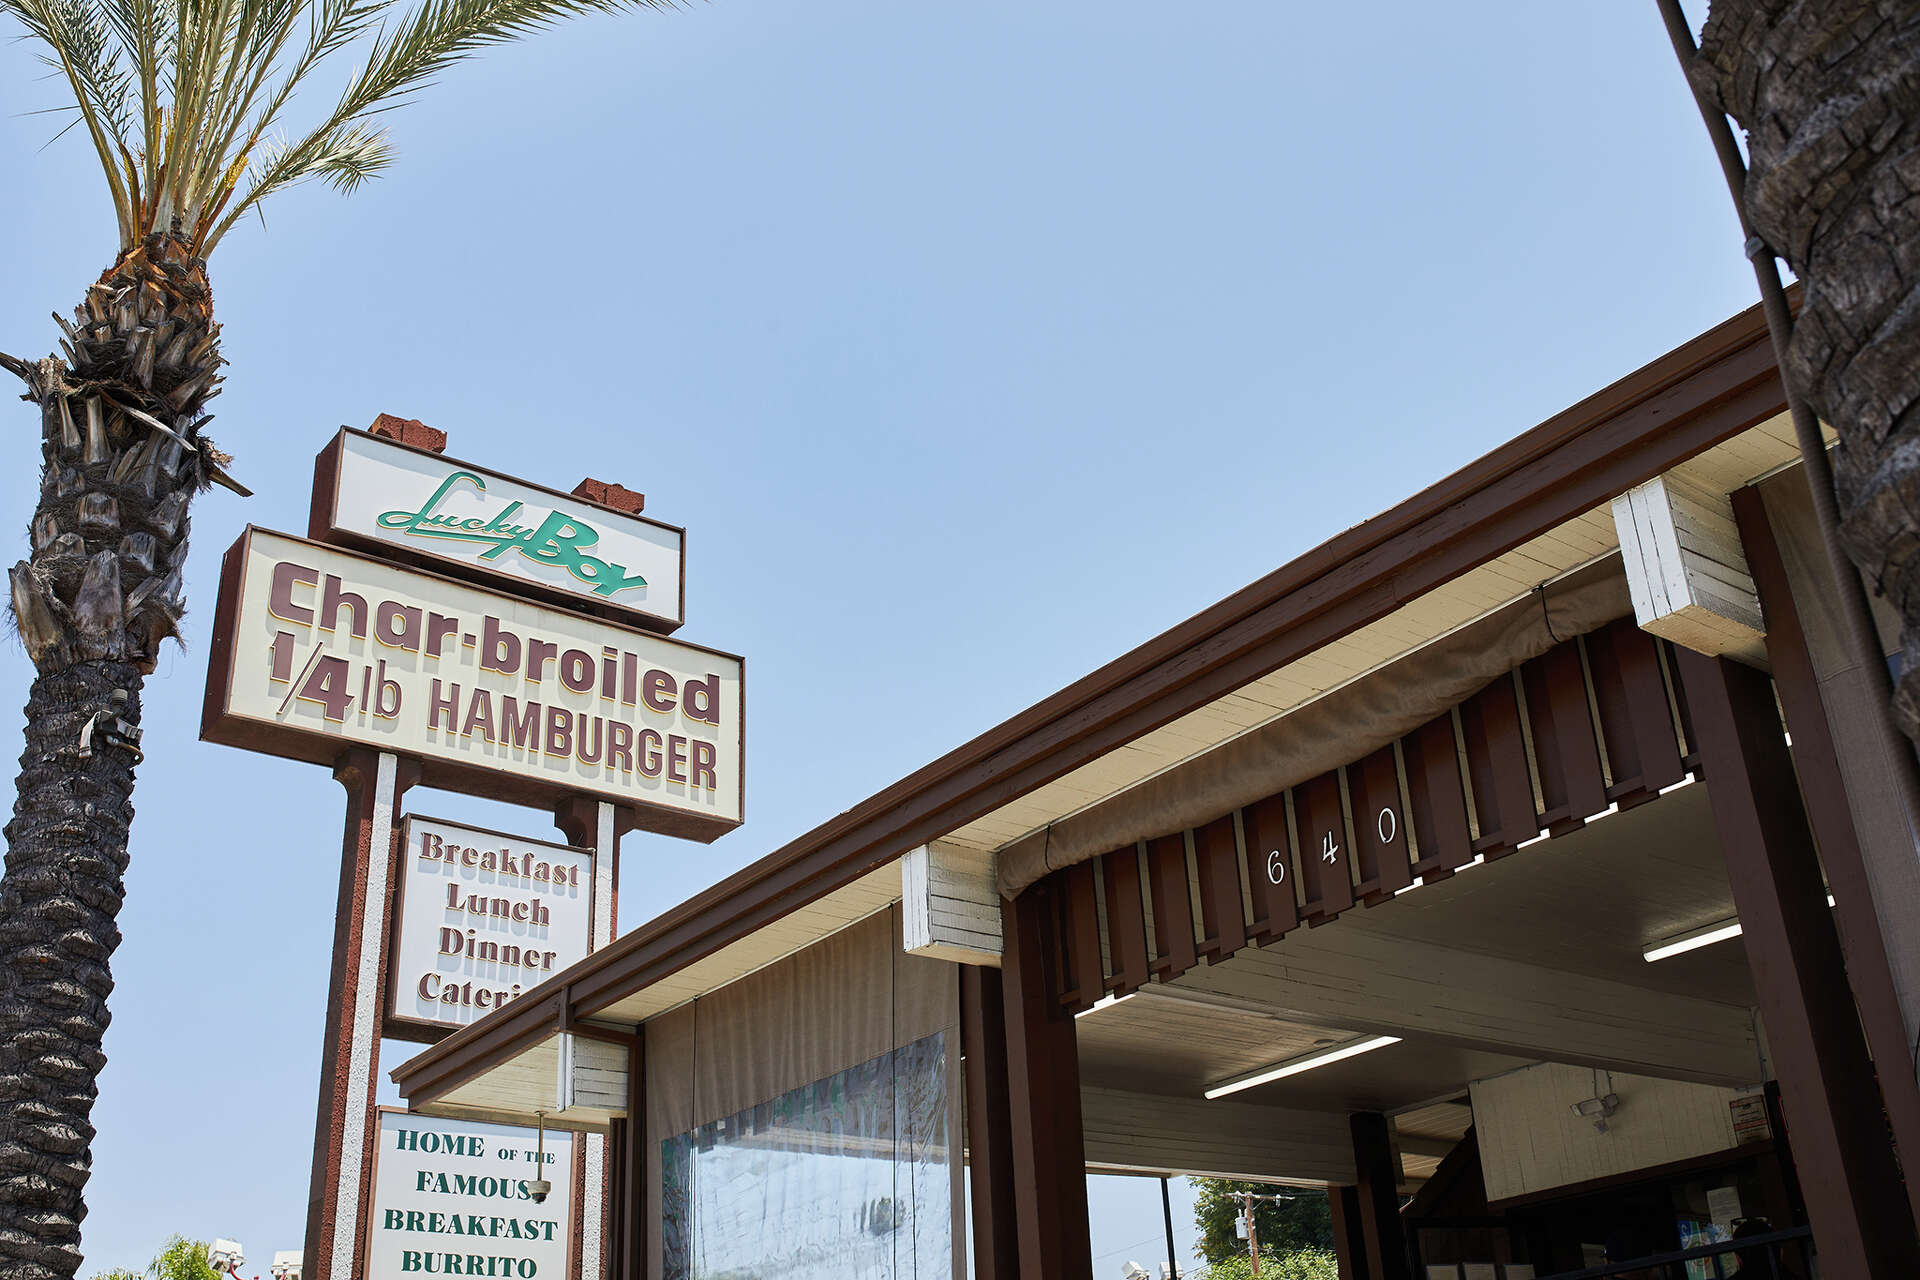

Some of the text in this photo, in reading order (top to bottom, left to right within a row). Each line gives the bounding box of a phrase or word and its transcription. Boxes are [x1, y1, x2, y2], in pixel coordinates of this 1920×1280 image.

[376, 471, 648, 598] Lucky Boy
[268, 561, 720, 726] Char-broiled
[427, 678, 718, 791] HAMBURGER
[418, 831, 579, 888] Breakfast
[446, 882, 551, 928] Lunch
[438, 926, 557, 971] Dinner
[396, 1129, 556, 1165] HOME OF THE
[415, 1170, 532, 1201] FAMOUS
[383, 1208, 559, 1242] BREAKFAST
[401, 1250, 538, 1280] BURRITO
